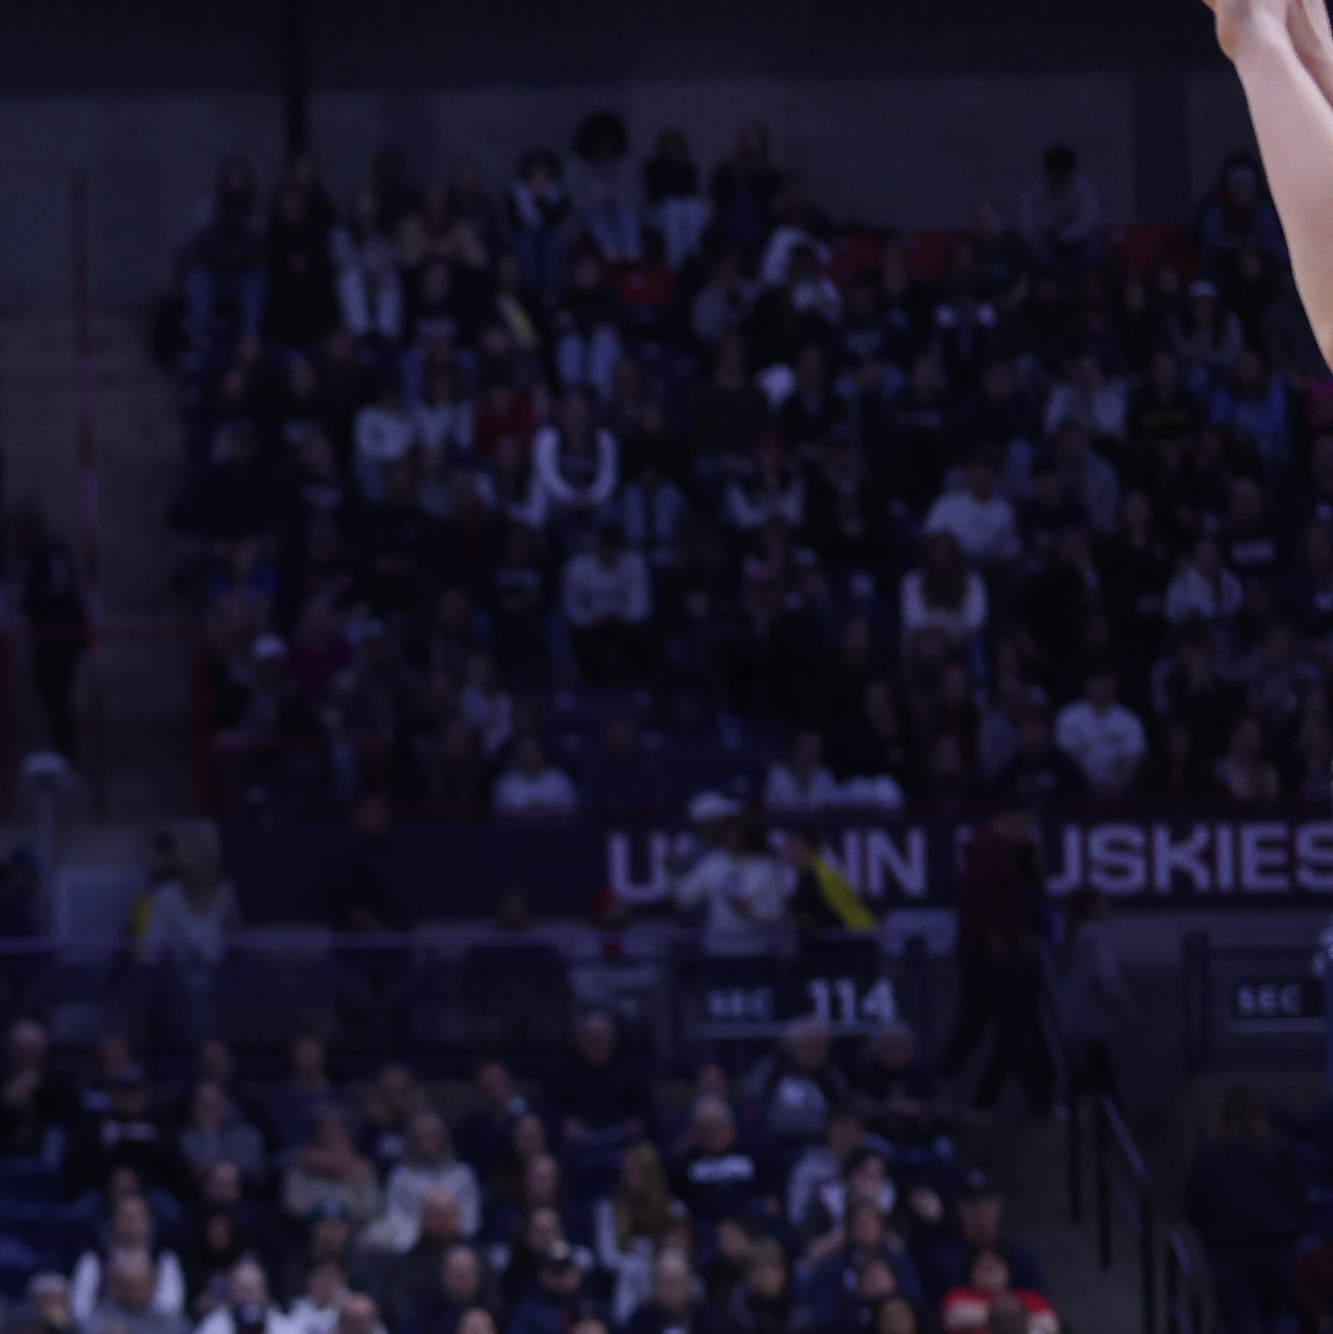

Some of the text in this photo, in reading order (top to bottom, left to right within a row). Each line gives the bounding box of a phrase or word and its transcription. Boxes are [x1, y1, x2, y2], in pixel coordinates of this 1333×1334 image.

[607, 816, 1333, 902] UNN USKIES
[806, 976, 897, 1028] 114
[1236, 984, 1302, 1016] SEC
